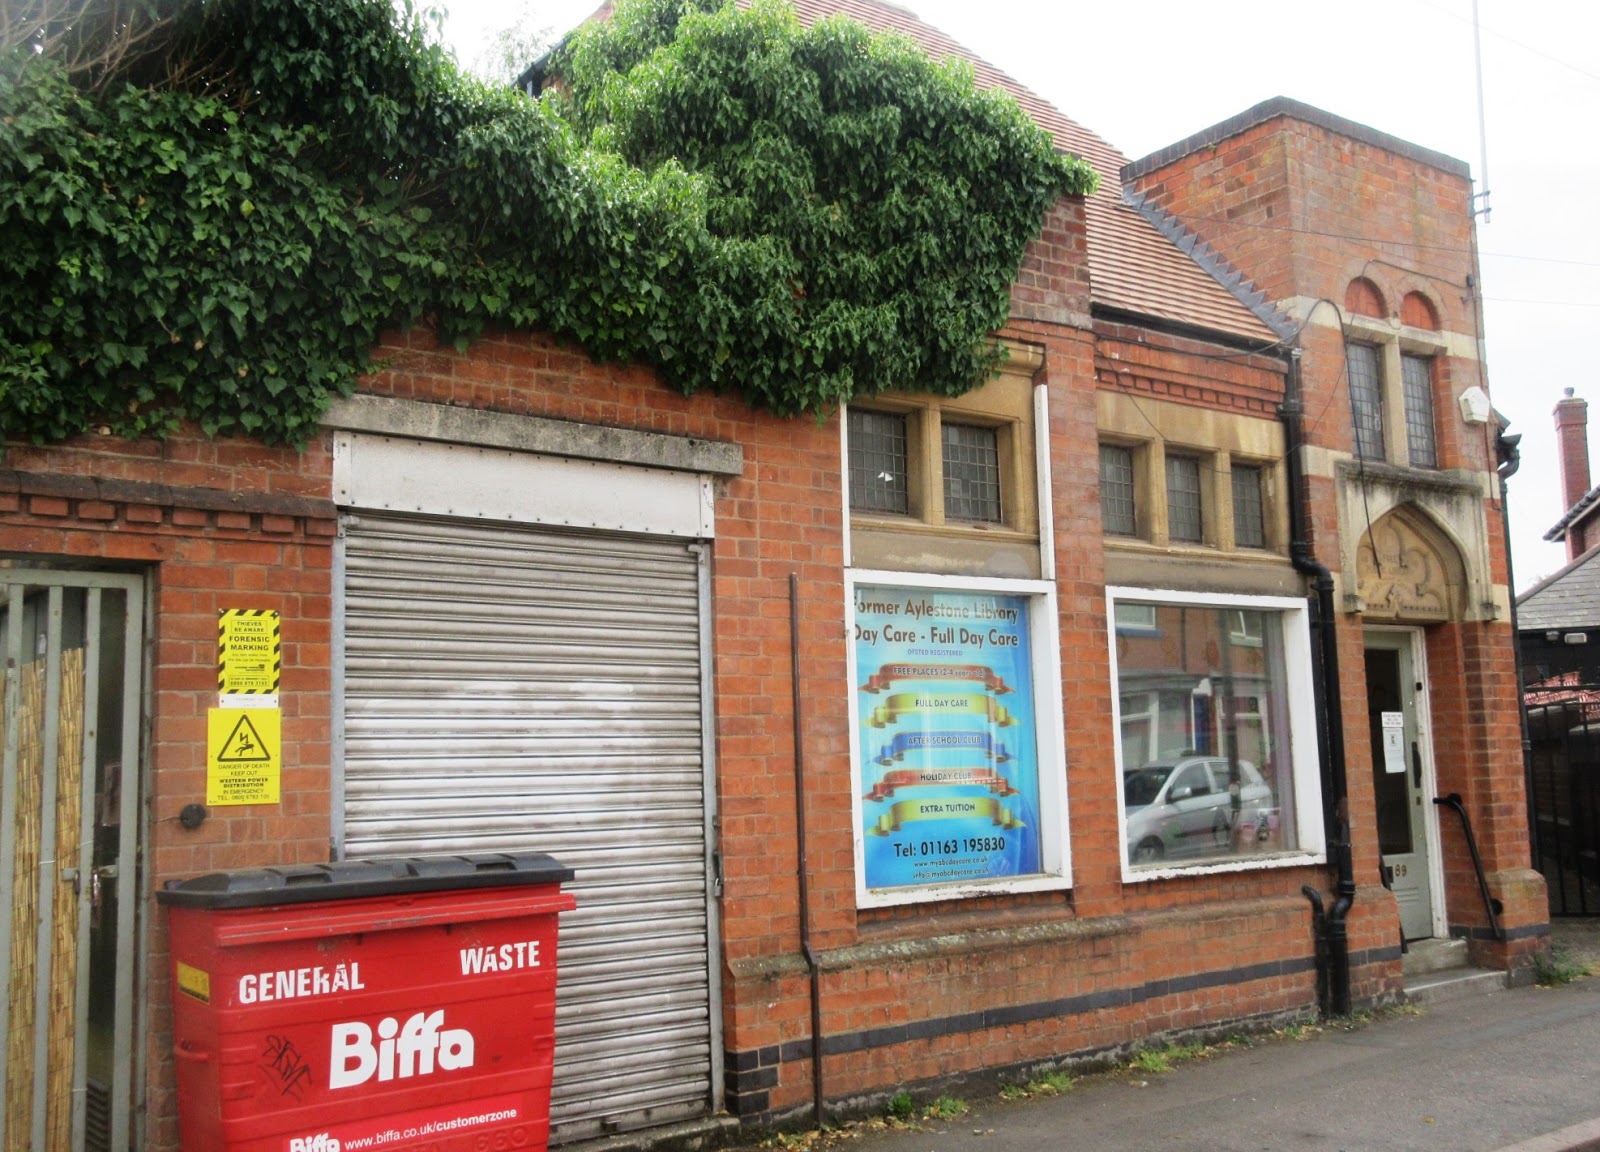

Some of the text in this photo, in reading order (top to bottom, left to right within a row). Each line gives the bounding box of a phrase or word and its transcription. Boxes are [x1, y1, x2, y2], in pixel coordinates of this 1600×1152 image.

[855, 596, 1018, 624] ormer Aylestone Library
[229, 635, 270, 643] FORENSIC
[883, 624, 916, 642] Care
[930, 626, 955, 644] Full
[960, 628, 984, 649] Day
[989, 628, 1018, 646] Care
[893, 667, 911, 675] FREE
[912, 667, 939, 676] PLACES
[915, 699, 968, 707] FULL DAY CARE
[908, 736, 981, 744] AFTER SCHOOL CLUB
[920, 772, 972, 781] HOLIDAY CLUB
[920, 803, 975, 813] EXTRA TUITION
[893, 836, 1005, 858] Tel: 01163 195830
[1395, 864, 1407, 877] 89
[239, 961, 365, 1005] GENERAL
[460, 940, 540, 976] WASTE
[329, 1009, 474, 1090] Biffa
[289, 1107, 517, 1152] Biffa www.biffa.co.uk/customerzone
